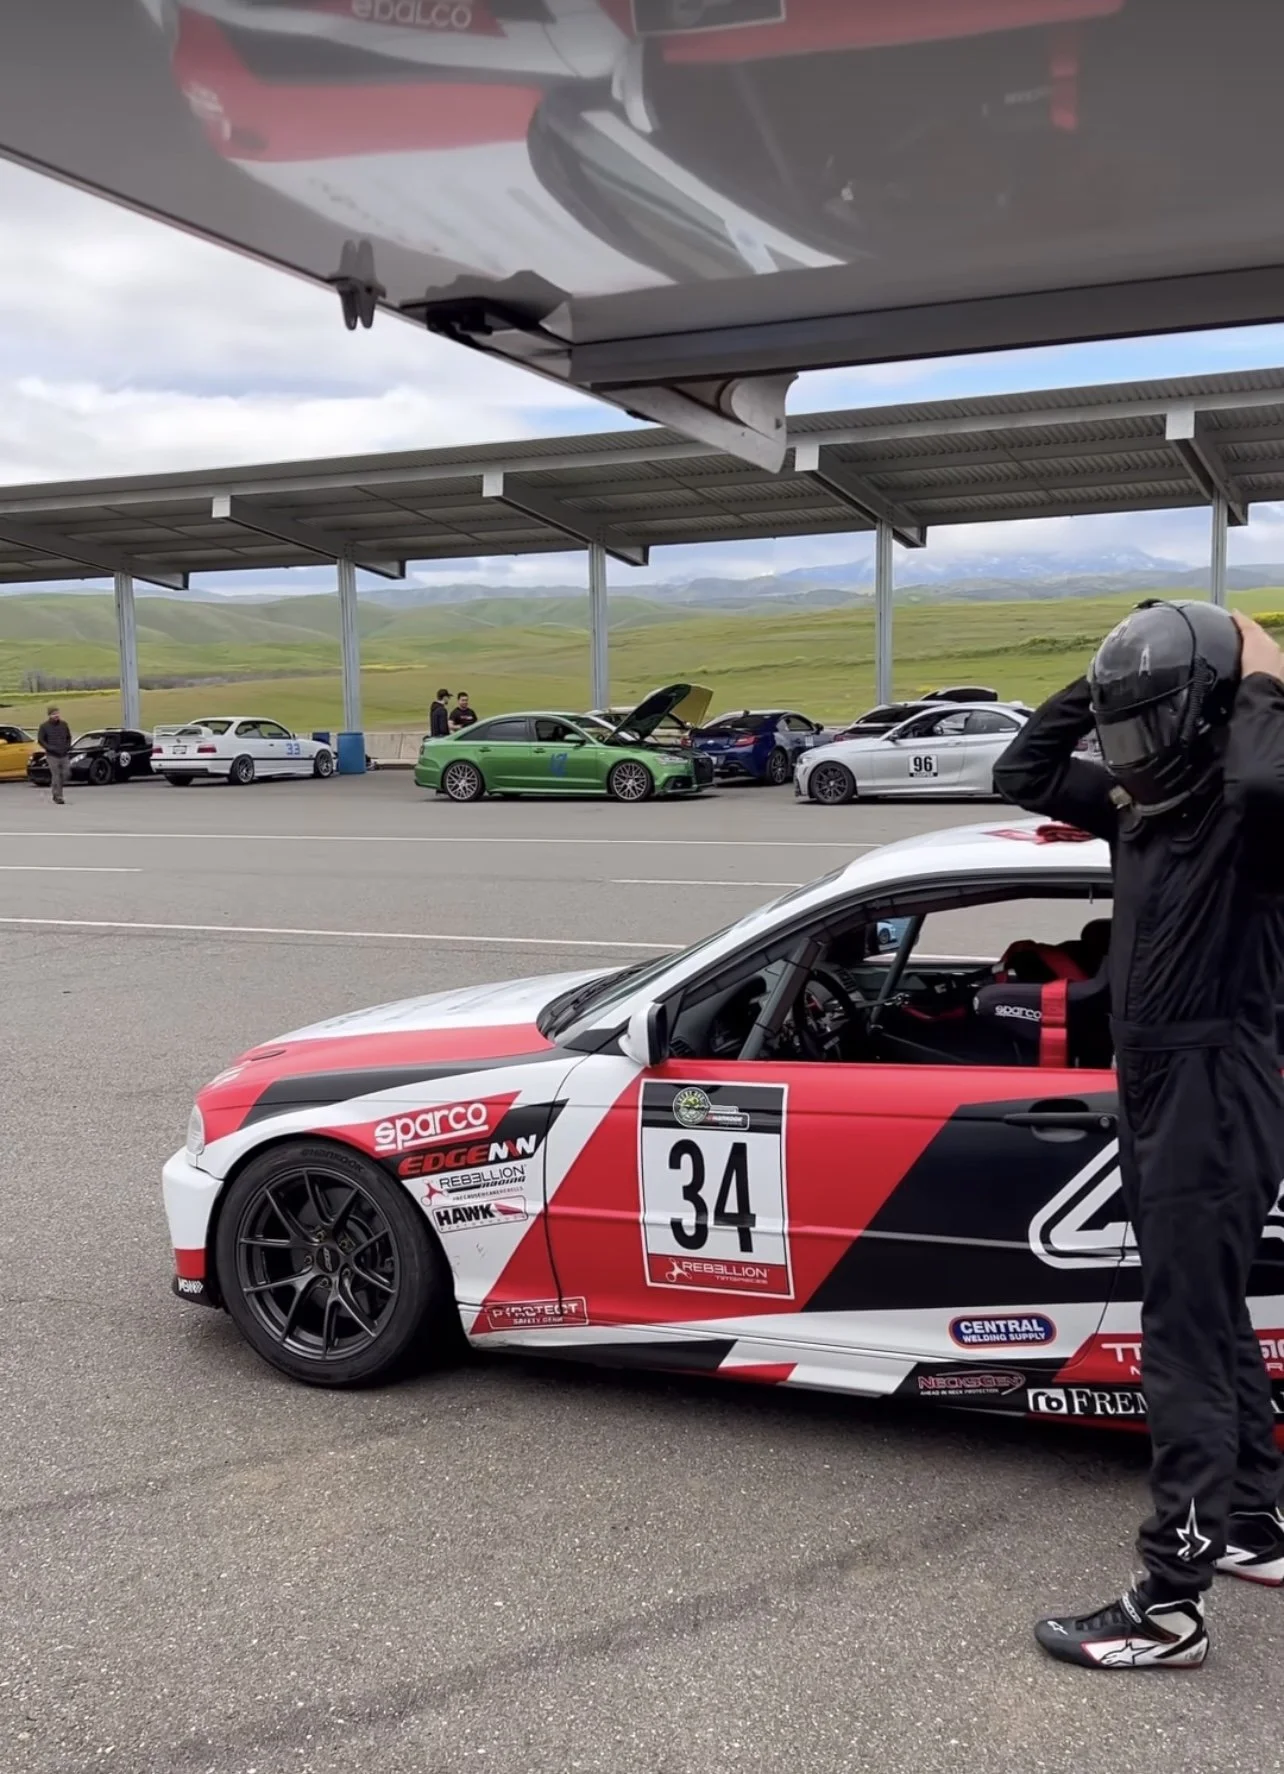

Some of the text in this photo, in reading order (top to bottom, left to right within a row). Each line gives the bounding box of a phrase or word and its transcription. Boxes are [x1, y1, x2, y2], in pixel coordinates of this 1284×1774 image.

[286, 742, 300, 755] 33
[913, 756, 932, 772] 96
[994, 1004, 1042, 1021] sparco
[374, 1102, 488, 1151] sparco
[668, 1138, 757, 1254] 34
[435, 1203, 496, 1227] HAWK
[960, 1319, 1044, 1334] CENTRAL
[963, 1332, 1046, 1343] WELDING SUPPLY
